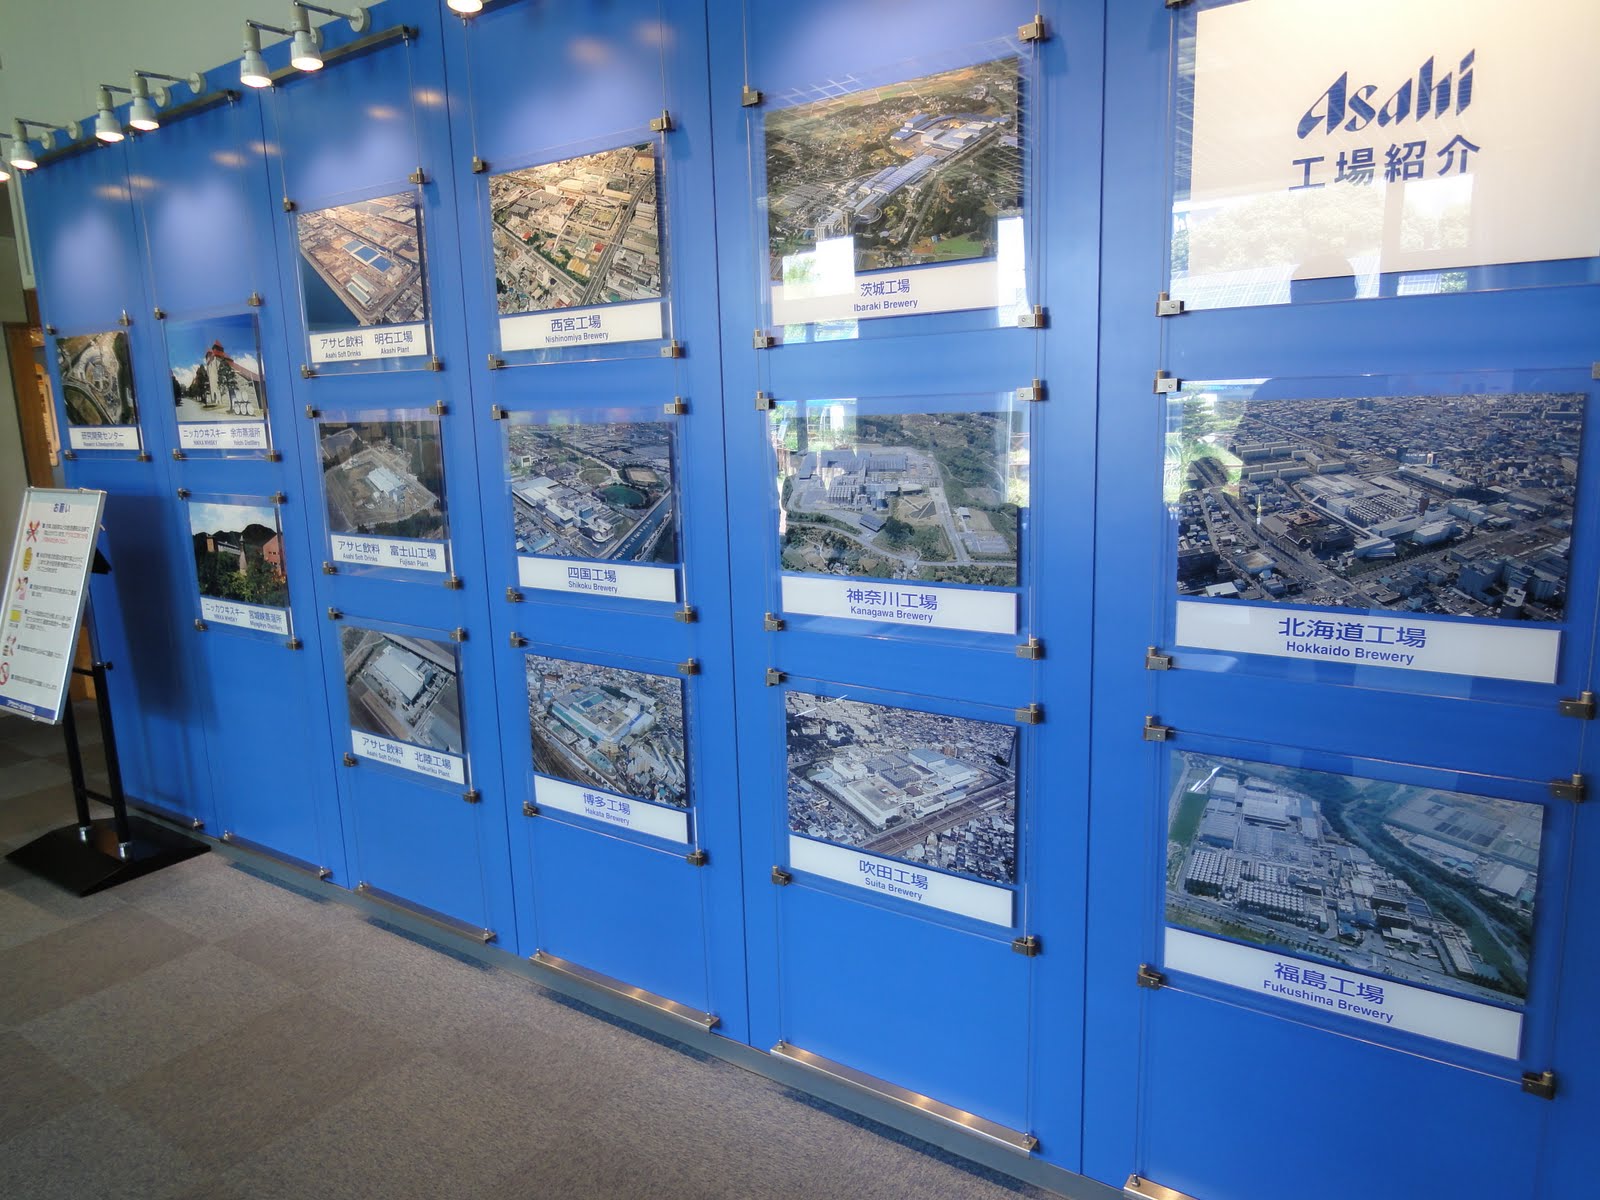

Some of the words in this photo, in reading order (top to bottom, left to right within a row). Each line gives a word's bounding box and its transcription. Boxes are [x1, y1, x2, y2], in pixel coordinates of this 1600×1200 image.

[1296, 48, 1475, 140] Asahi
[1288, 134, 1481, 192] 工場紹介
[860, 279, 911, 297] 茨城工場
[853, 302, 881, 312] Ibaraki
[883, 300, 918, 310] Brewery
[551, 315, 601, 332] 西宮工場
[320, 335, 363, 349] アサヒ飲料
[374, 331, 413, 345] 明石工場
[545, 334, 582, 343] Nishinomiya
[583, 332, 609, 340] Brewery
[338, 541, 380, 554] アサヒ飲料
[390, 545, 437, 560] 富士山工場
[400, 559, 416, 567] Fujisan
[568, 567, 616, 583] 四国工場
[568, 581, 592, 590] Shikoku
[593, 583, 618, 593] Brewery
[846, 588, 938, 611] 神奈川工場
[850, 606, 894, 618] Kanagawa
[896, 610, 933, 623] Brewery
[1278, 617, 1427, 648] 北海道工場
[1286, 641, 1350, 657] Hokkaido
[1355, 648, 1415, 666] Brewery
[362, 737, 404, 757] アサヒ飲料
[414, 752, 452, 770] 北陸工場
[583, 792, 631, 816] 博多工場
[585, 807, 605, 818] Hakata
[606, 812, 630, 826] Brewery
[859, 860, 928, 890] 吹田工場
[865, 877, 886, 890] Suita
[888, 884, 923, 901] Brewery
[1274, 962, 1385, 1005] 福島工場
[1263, 980, 1334, 1006] Fukushima
[1338, 999, 1394, 1023] Brewery
